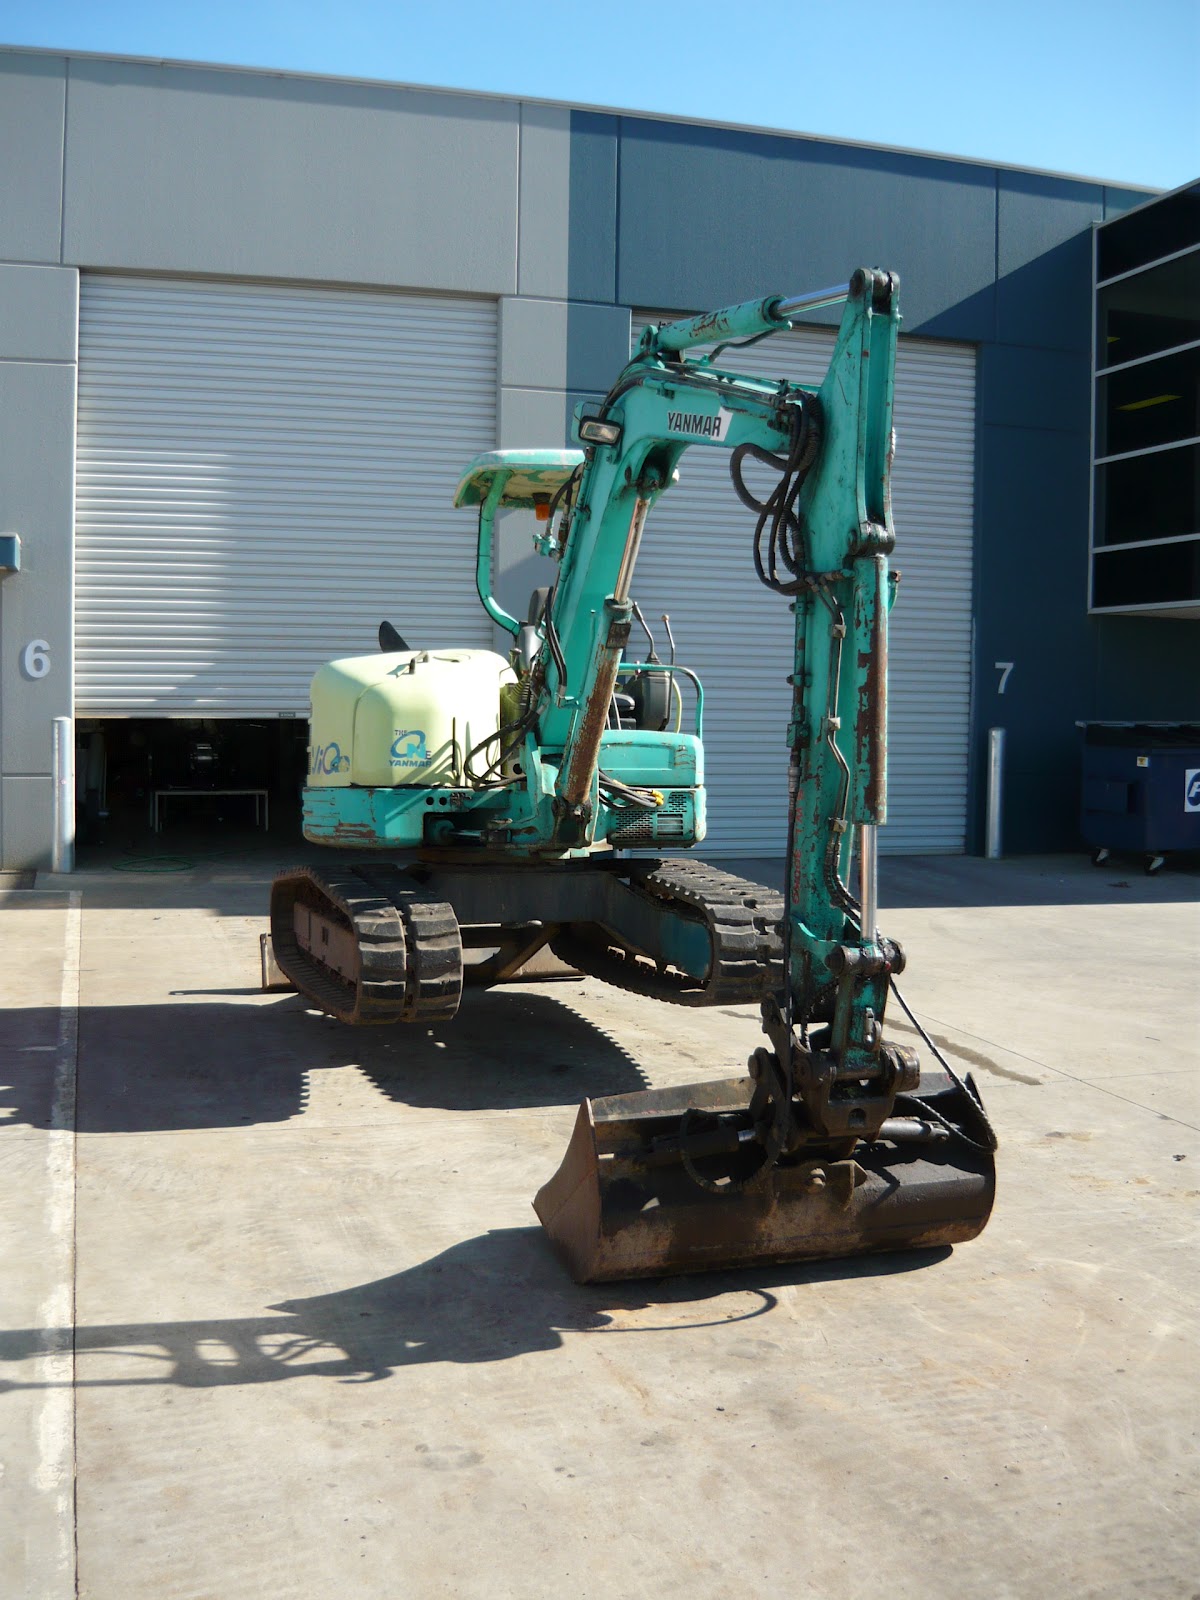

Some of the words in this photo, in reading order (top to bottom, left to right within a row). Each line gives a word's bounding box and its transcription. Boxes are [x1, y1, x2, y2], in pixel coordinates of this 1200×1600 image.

[667, 411, 722, 437] YANMAR
[24, 639, 51, 678] 6
[994, 662, 1014, 694] 7
[388, 760, 432, 768] YANMAR
